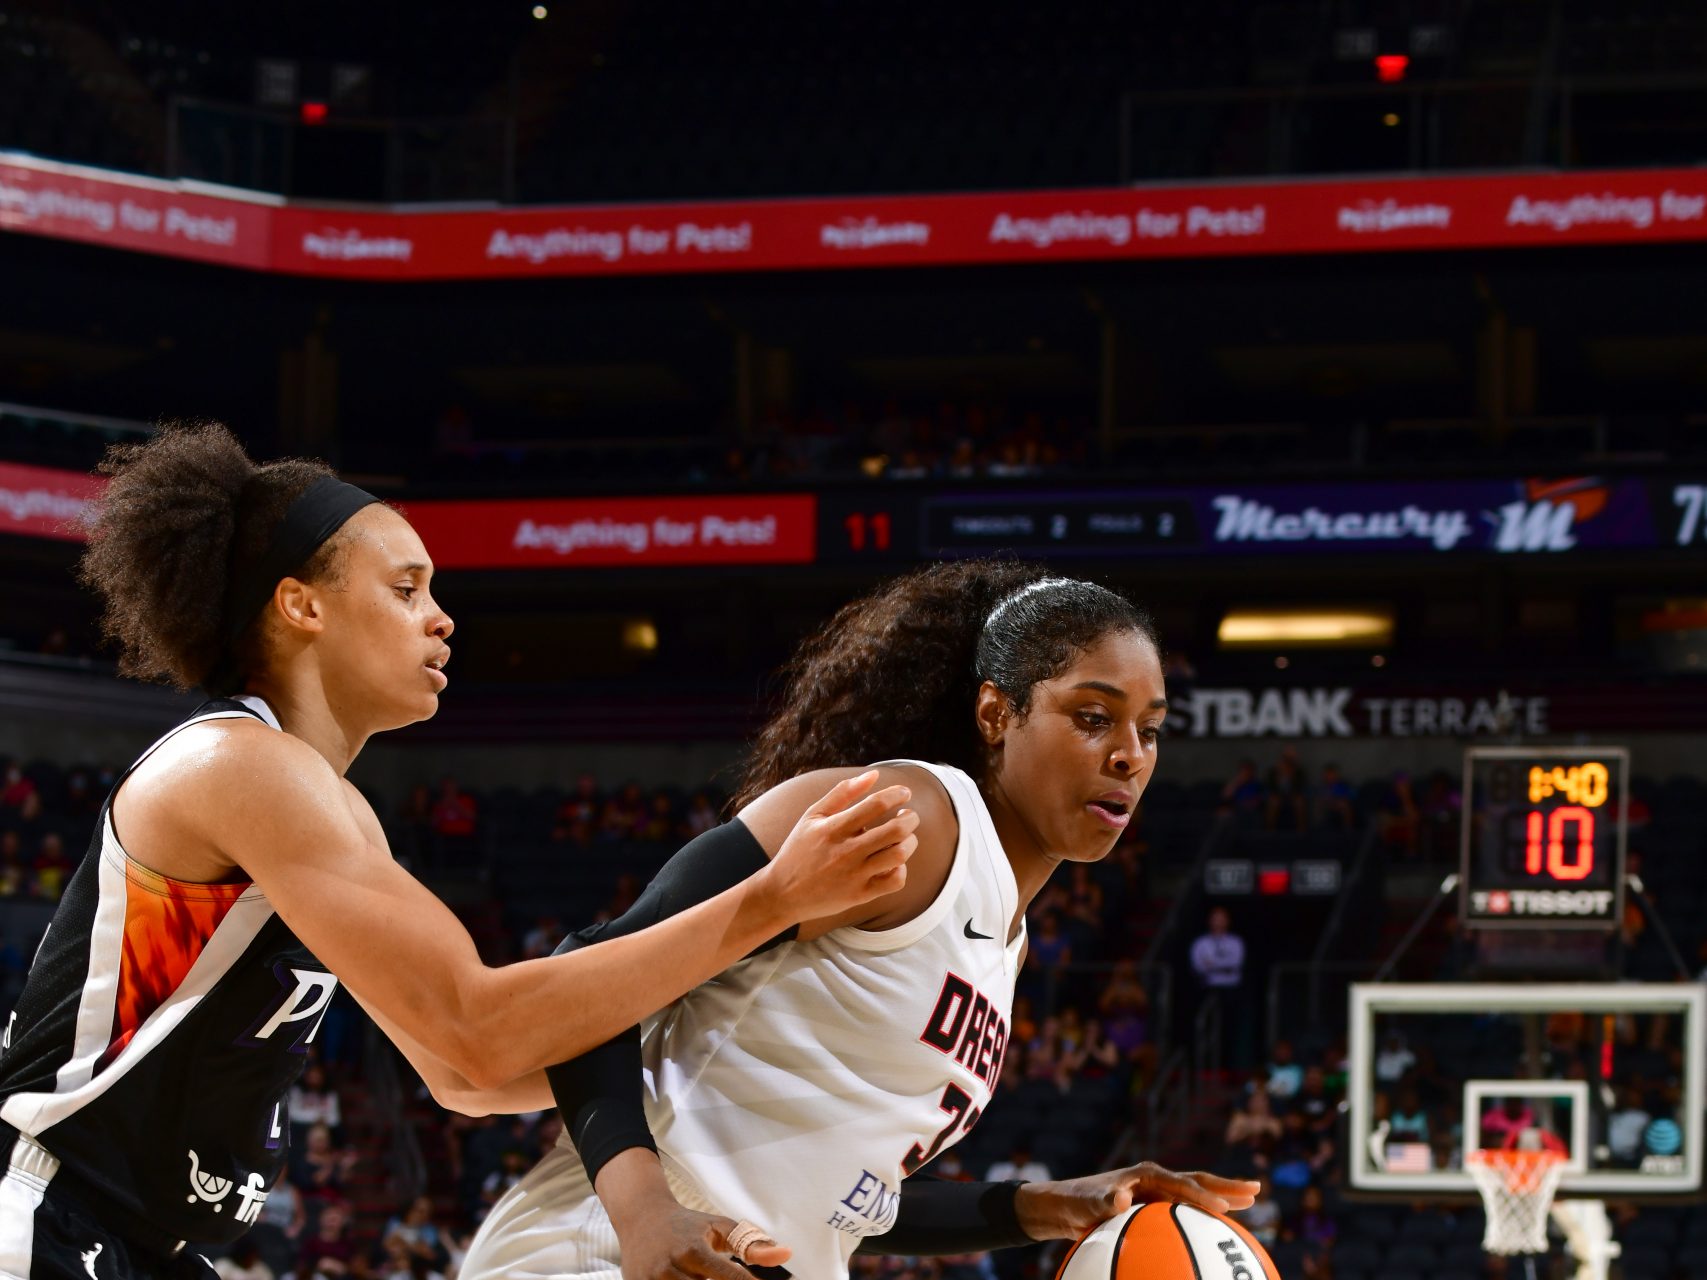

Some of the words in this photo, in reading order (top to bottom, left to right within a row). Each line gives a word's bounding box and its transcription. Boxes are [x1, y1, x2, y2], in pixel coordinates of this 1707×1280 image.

[119, 200, 159, 233] for
[989, 212, 1131, 247] Anything
[1136, 208, 1181, 238] for
[1186, 204, 1265, 236] Pets!
[1506, 195, 1654, 231] Anything
[1660, 190, 1704, 220] for
[486, 228, 623, 264] Anything
[627, 224, 670, 254] for
[676, 222, 751, 252] Pets!
[514, 519, 648, 553] Anything
[654, 515, 697, 545] for
[701, 514, 776, 545] Pets!
[846, 513, 891, 551] 11
[1213, 495, 1470, 549] Mercury
[1525, 806, 1595, 880] 10
[1511, 890, 1614, 916] TISSOT
[919, 971, 1008, 1097] DREA
